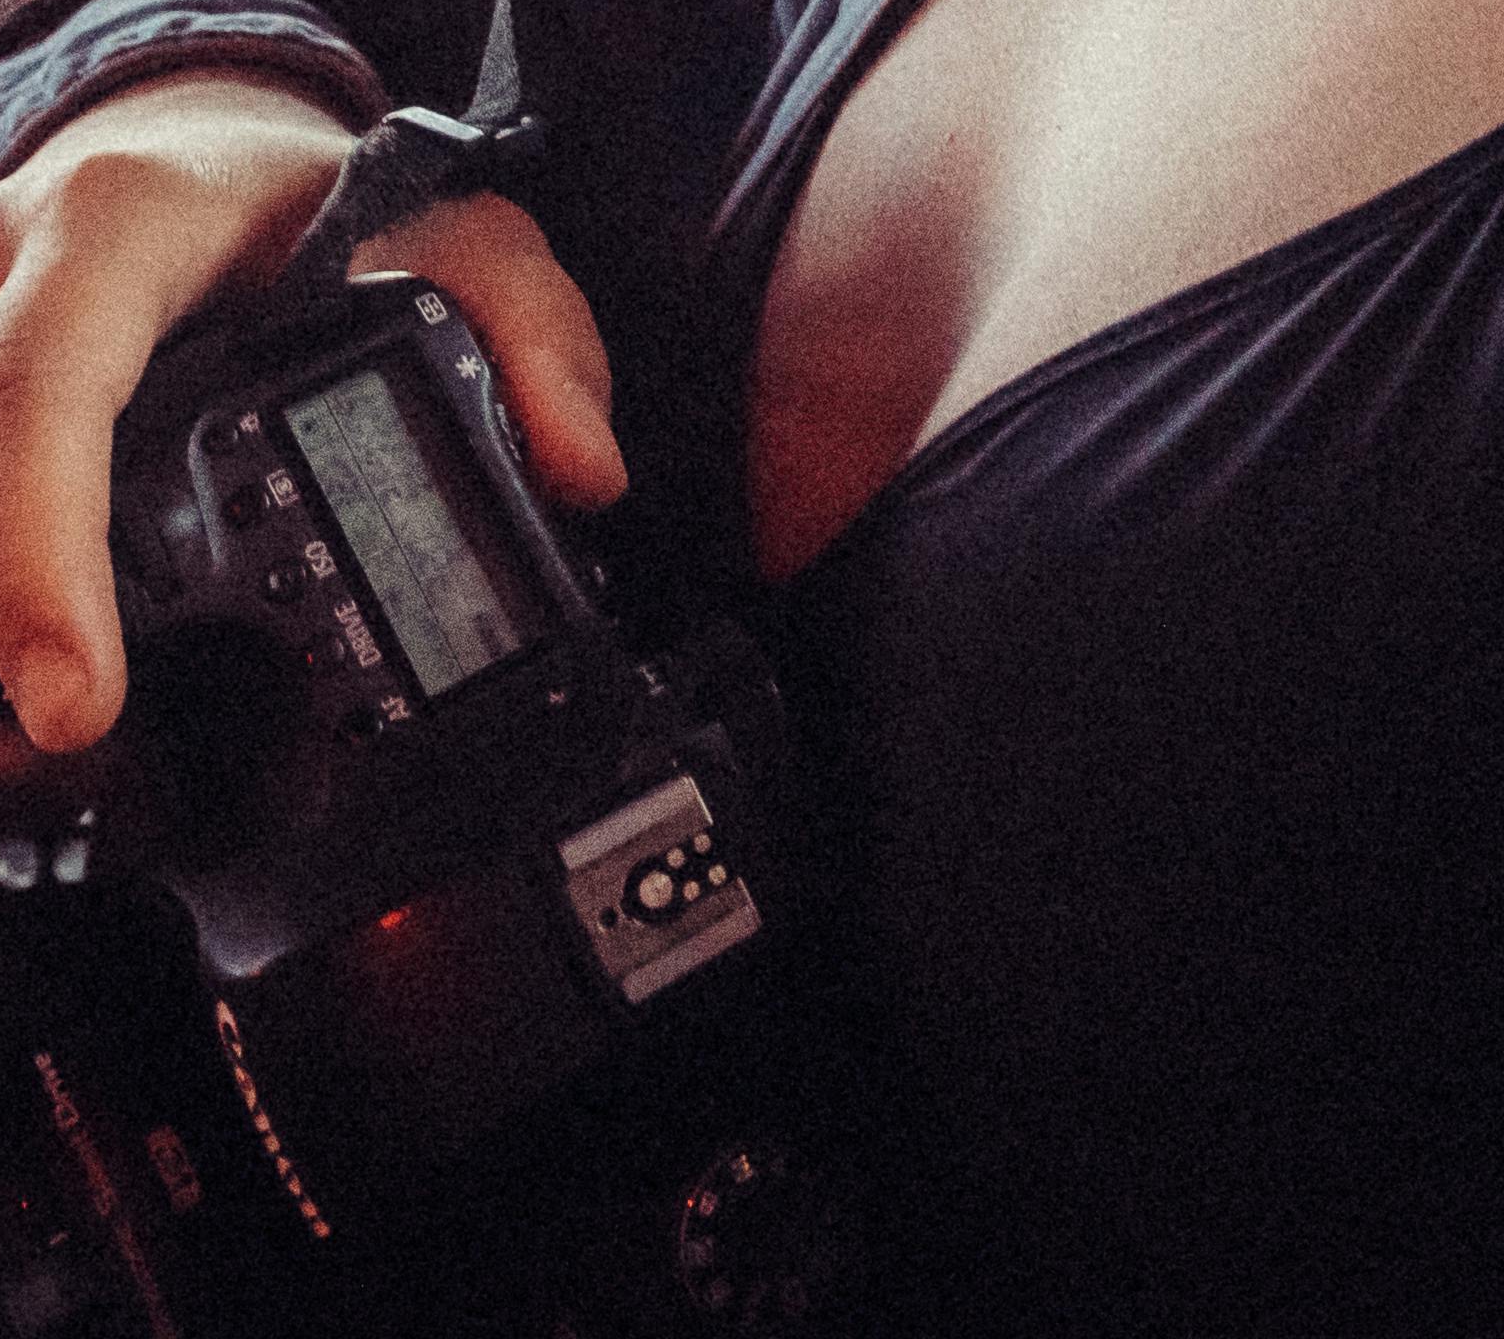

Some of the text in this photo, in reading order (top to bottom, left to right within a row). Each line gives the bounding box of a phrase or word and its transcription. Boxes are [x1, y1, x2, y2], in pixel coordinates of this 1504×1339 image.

[304, 539, 337, 580] ISO
[335, 600, 382, 667] DRIVE
[381, 694, 410, 722] AF
